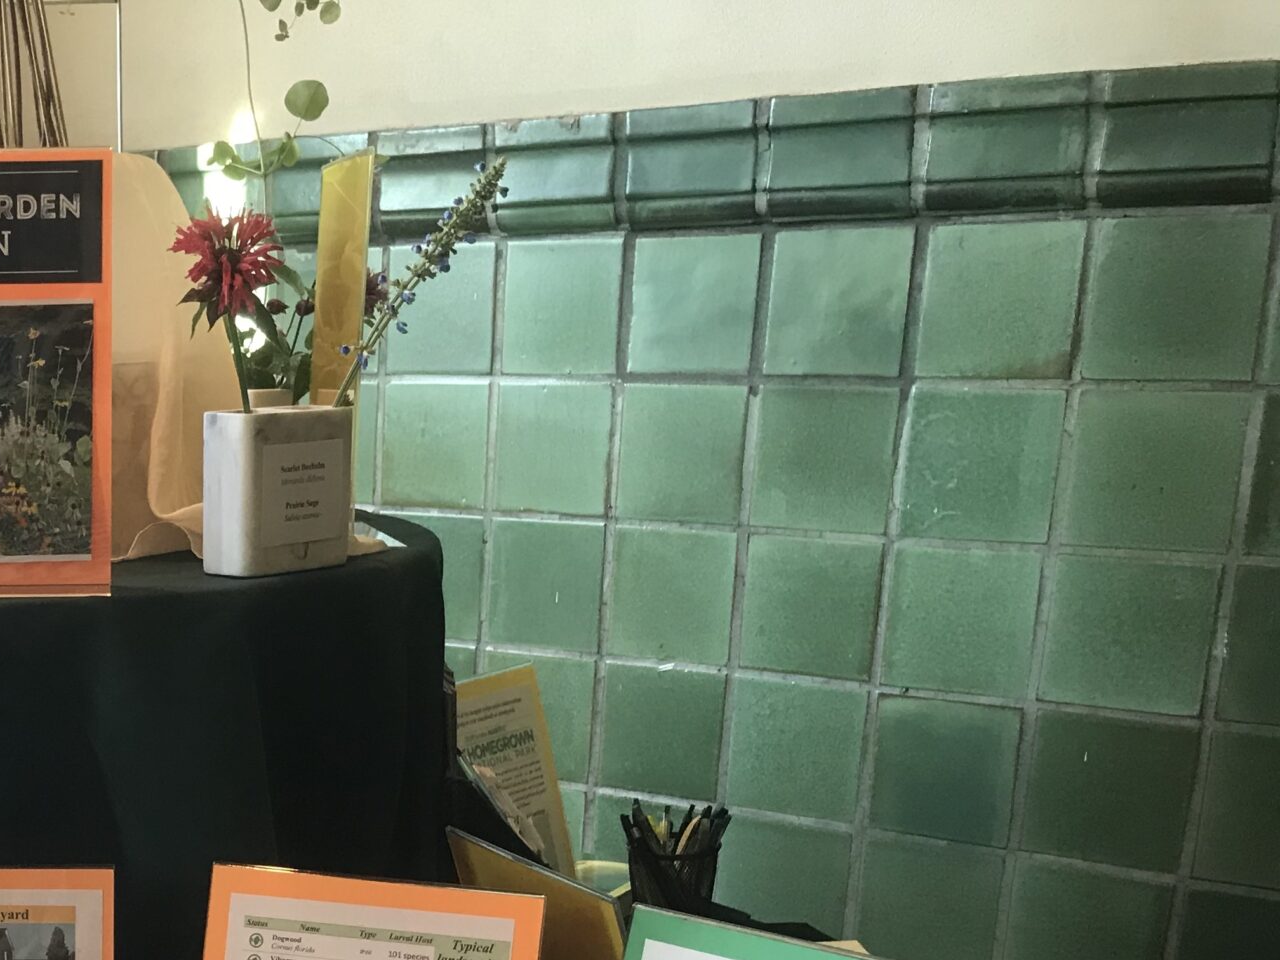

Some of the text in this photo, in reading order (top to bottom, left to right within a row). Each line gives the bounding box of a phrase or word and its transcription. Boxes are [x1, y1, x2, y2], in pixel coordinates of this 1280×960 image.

[0, 908, 29, 922] yard
[452, 939, 494, 954] Typical
[387, 950, 429, 960] 101 species
